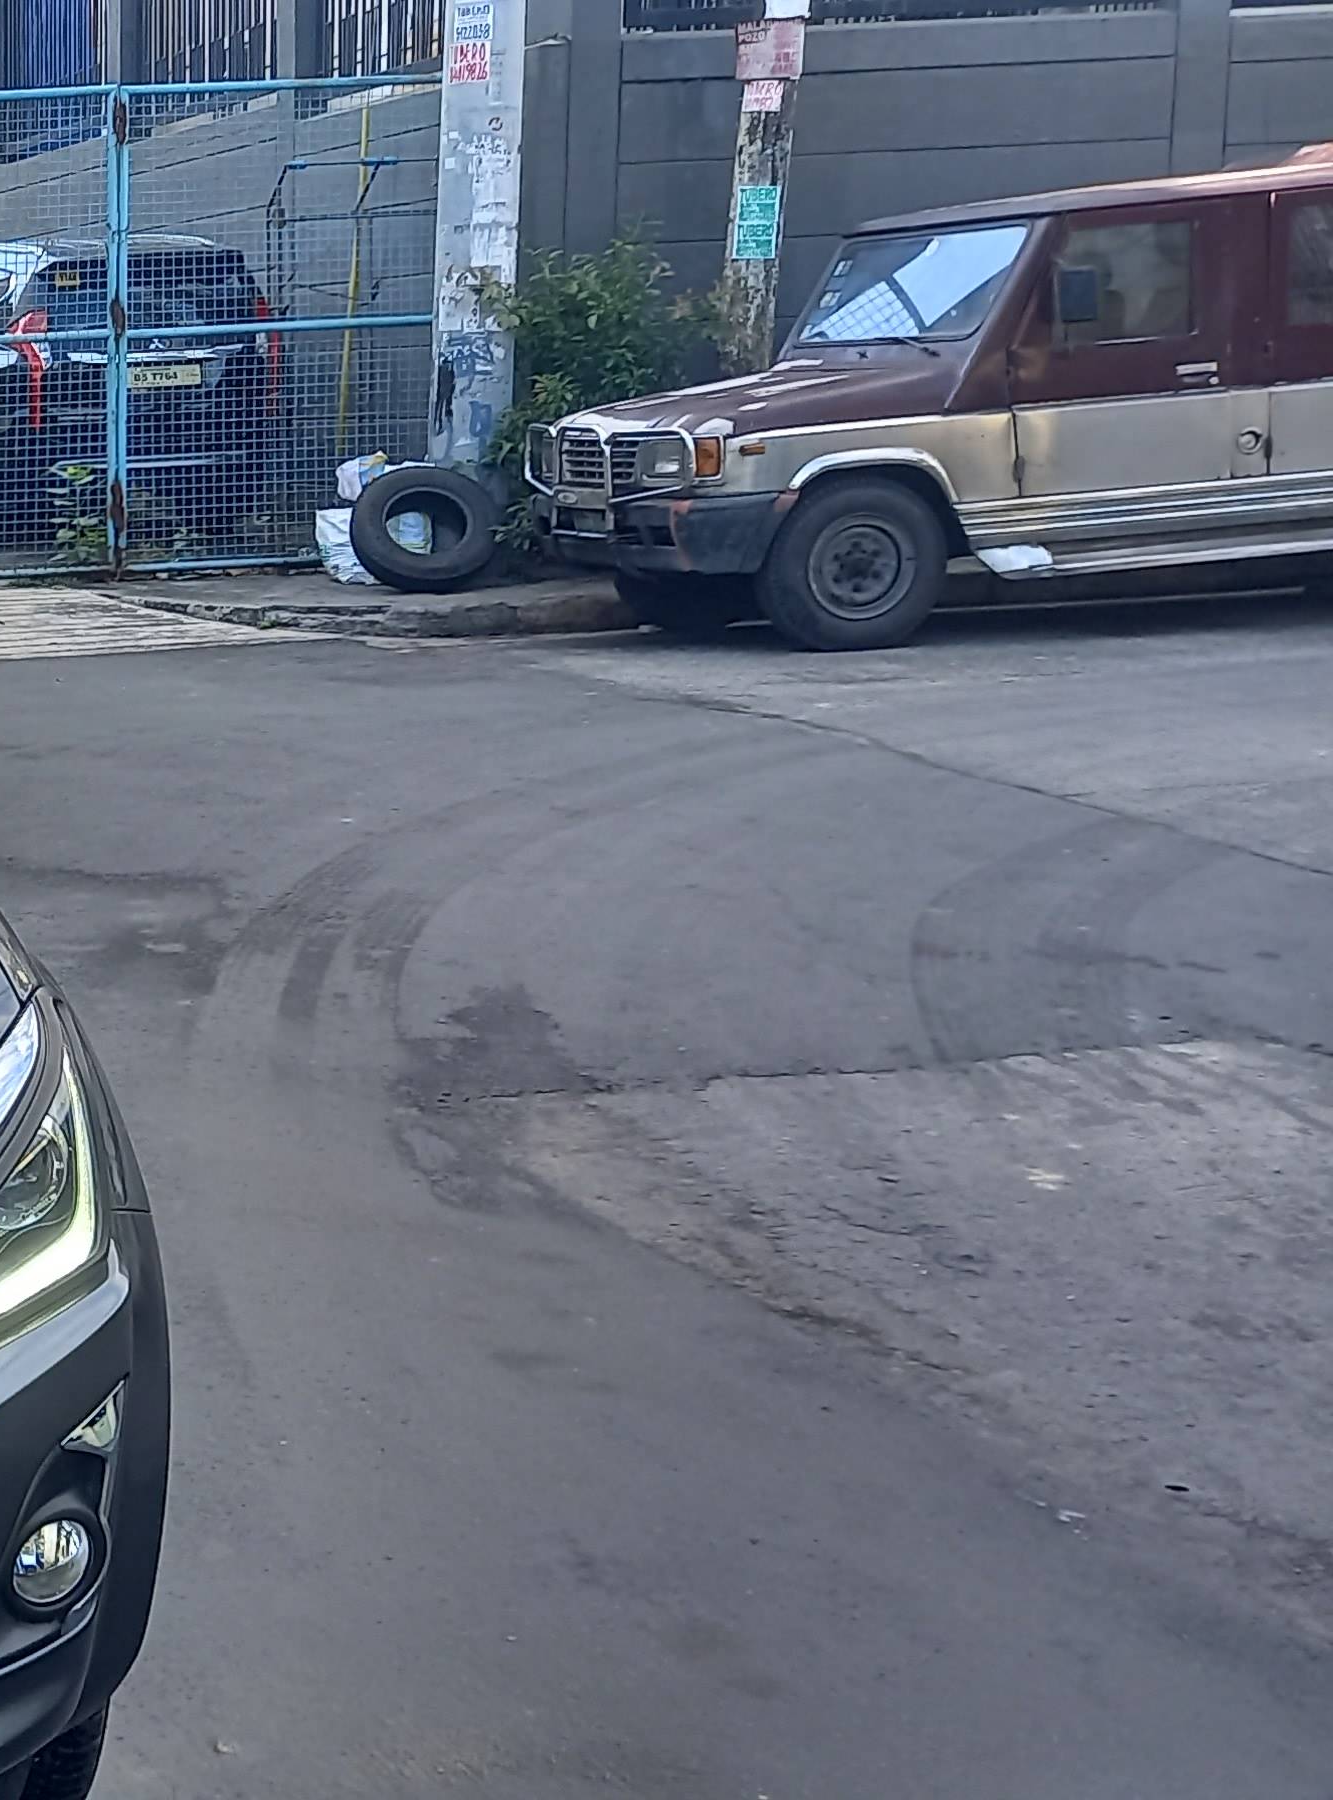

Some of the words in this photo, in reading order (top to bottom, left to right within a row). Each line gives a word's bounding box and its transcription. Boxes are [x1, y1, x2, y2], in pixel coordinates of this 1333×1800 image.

[738, 30, 766, 43] POZO
[739, 187, 777, 203] TUBERO
[737, 223, 774, 238] TUBERO
